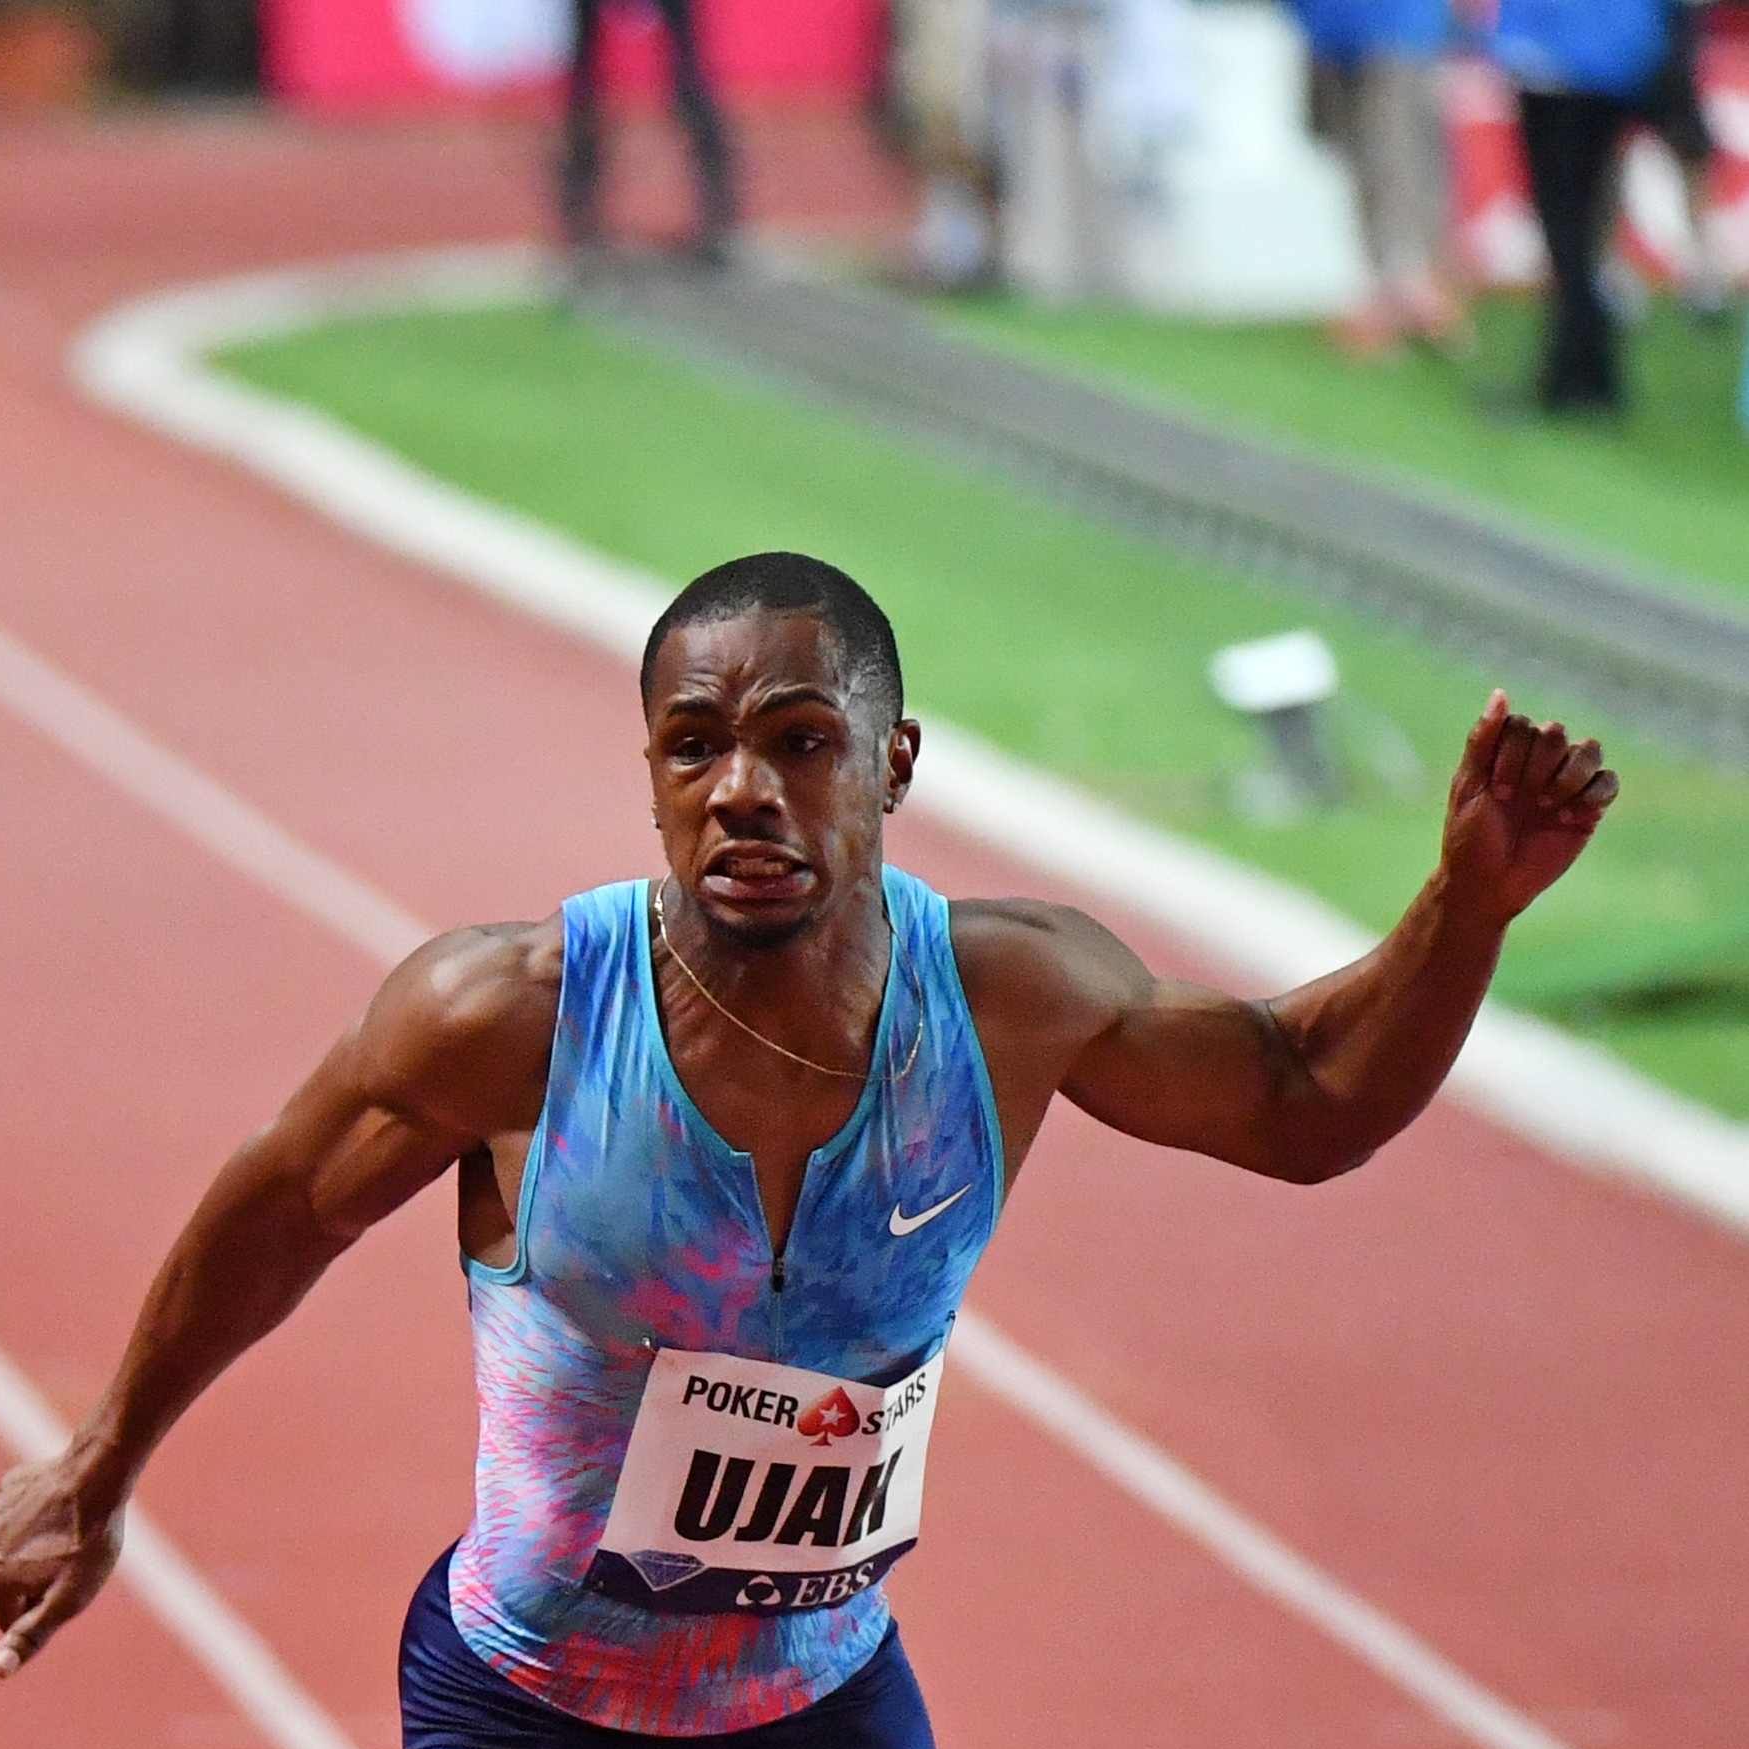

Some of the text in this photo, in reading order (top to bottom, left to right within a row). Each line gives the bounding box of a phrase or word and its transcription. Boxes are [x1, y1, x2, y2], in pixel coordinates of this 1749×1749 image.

[681, 1371, 927, 1436] POKER STARS
[673, 1447, 903, 1548] UJAH
[789, 1561, 875, 1608] EBS
